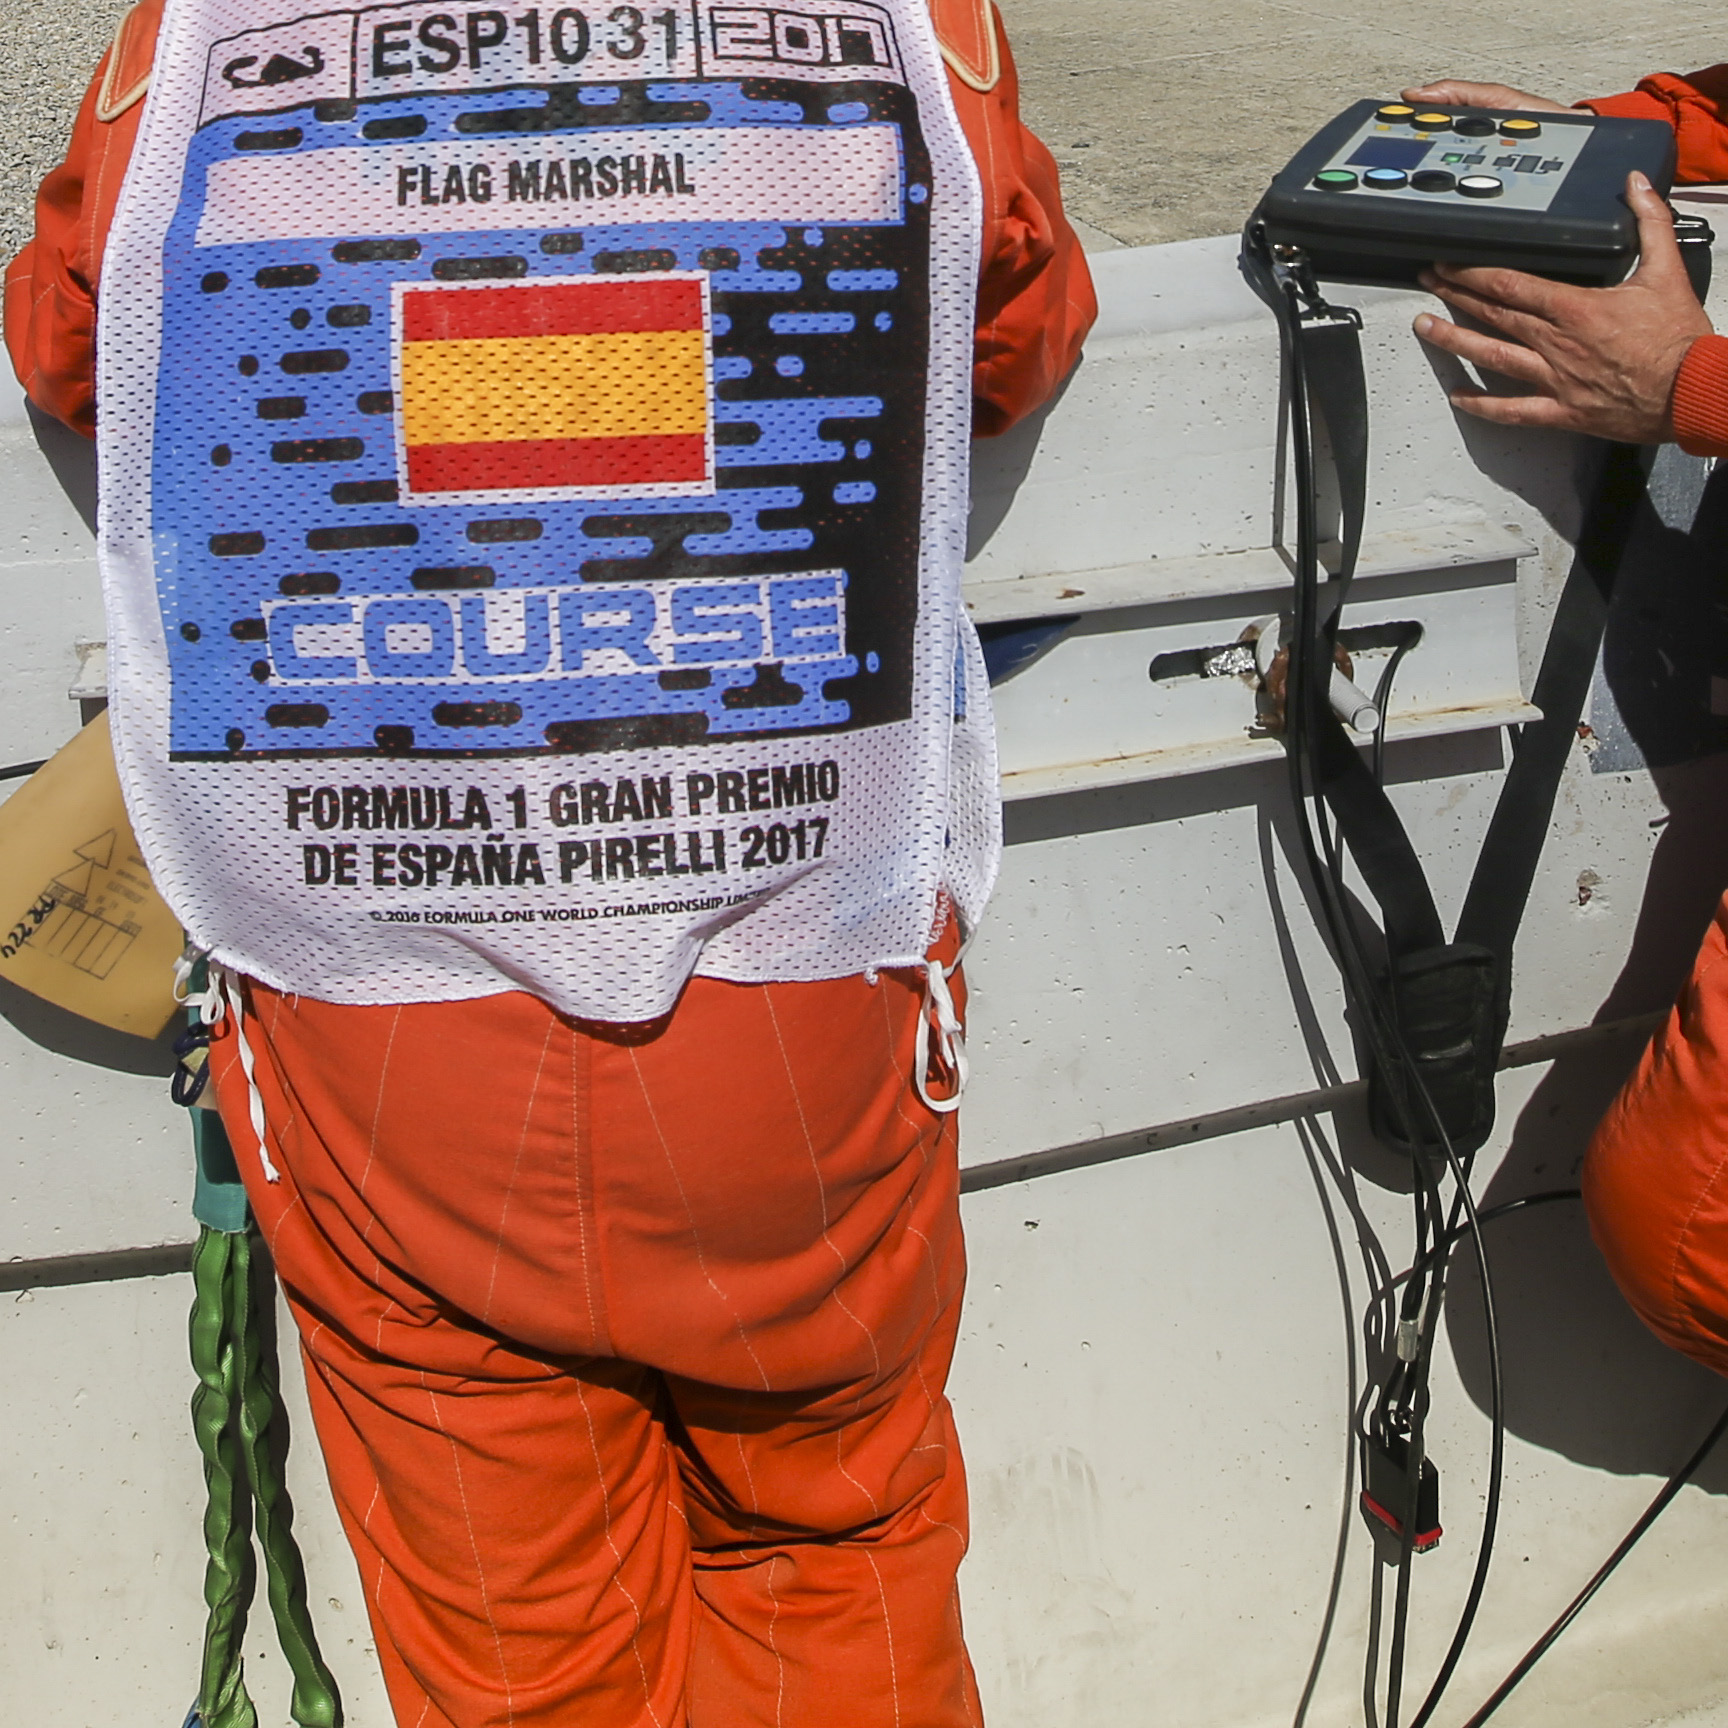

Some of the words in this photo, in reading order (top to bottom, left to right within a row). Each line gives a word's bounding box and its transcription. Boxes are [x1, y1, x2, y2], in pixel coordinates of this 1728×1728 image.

[373, 8, 590, 78] ESP10
[606, 5, 678, 69] 31
[396, 160, 492, 207] FLAG
[508, 154, 695, 203] MARSHAL
[269, 576, 843, 682] COURSE
[286, 786, 491, 830] FORMULA
[506, 788, 526, 829] 1
[550, 774, 678, 828] GRAN
[694, 760, 840, 817] PREMIO
[304, 843, 365, 884] DE
[373, 833, 546, 887] ESPAÑA
[559, 829, 726, 881] PIRELLI
[740, 818, 829, 869] 2017
[424, 911, 496, 923] FORMULA
[500, 911, 536, 923] ONE
[541, 908, 598, 921] WORLD
[603, 897, 723, 918] CHAMPIONSHIP
